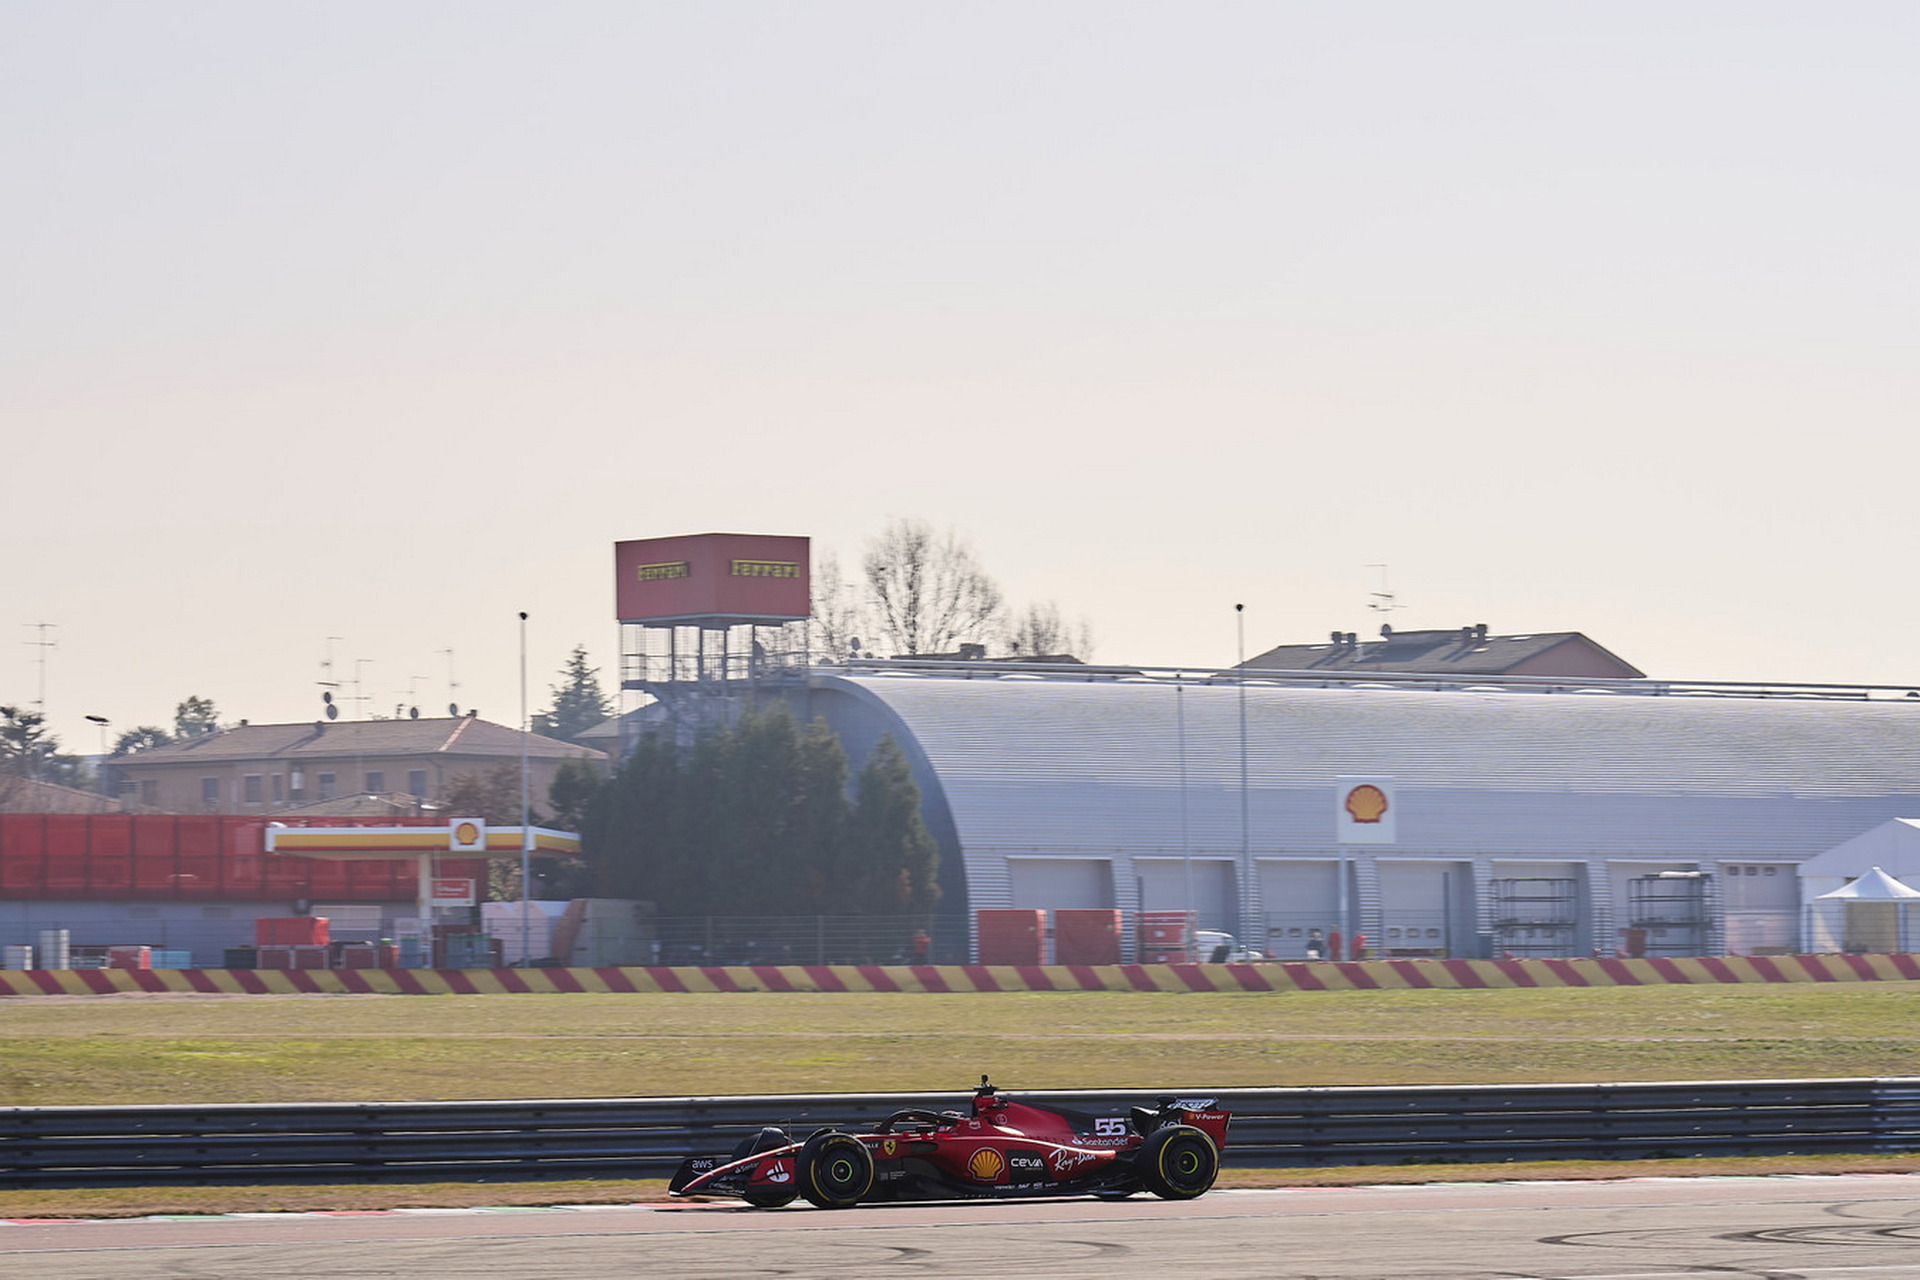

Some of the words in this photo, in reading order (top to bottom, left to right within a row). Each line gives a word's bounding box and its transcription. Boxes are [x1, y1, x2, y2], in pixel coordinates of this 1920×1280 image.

[638, 561, 689, 581] Ferrari
[730, 559, 800, 578] Ferrari
[1095, 1117, 1126, 1136] 55
[1082, 1137, 1128, 1146] Santander
[692, 1160, 713, 1169] aws
